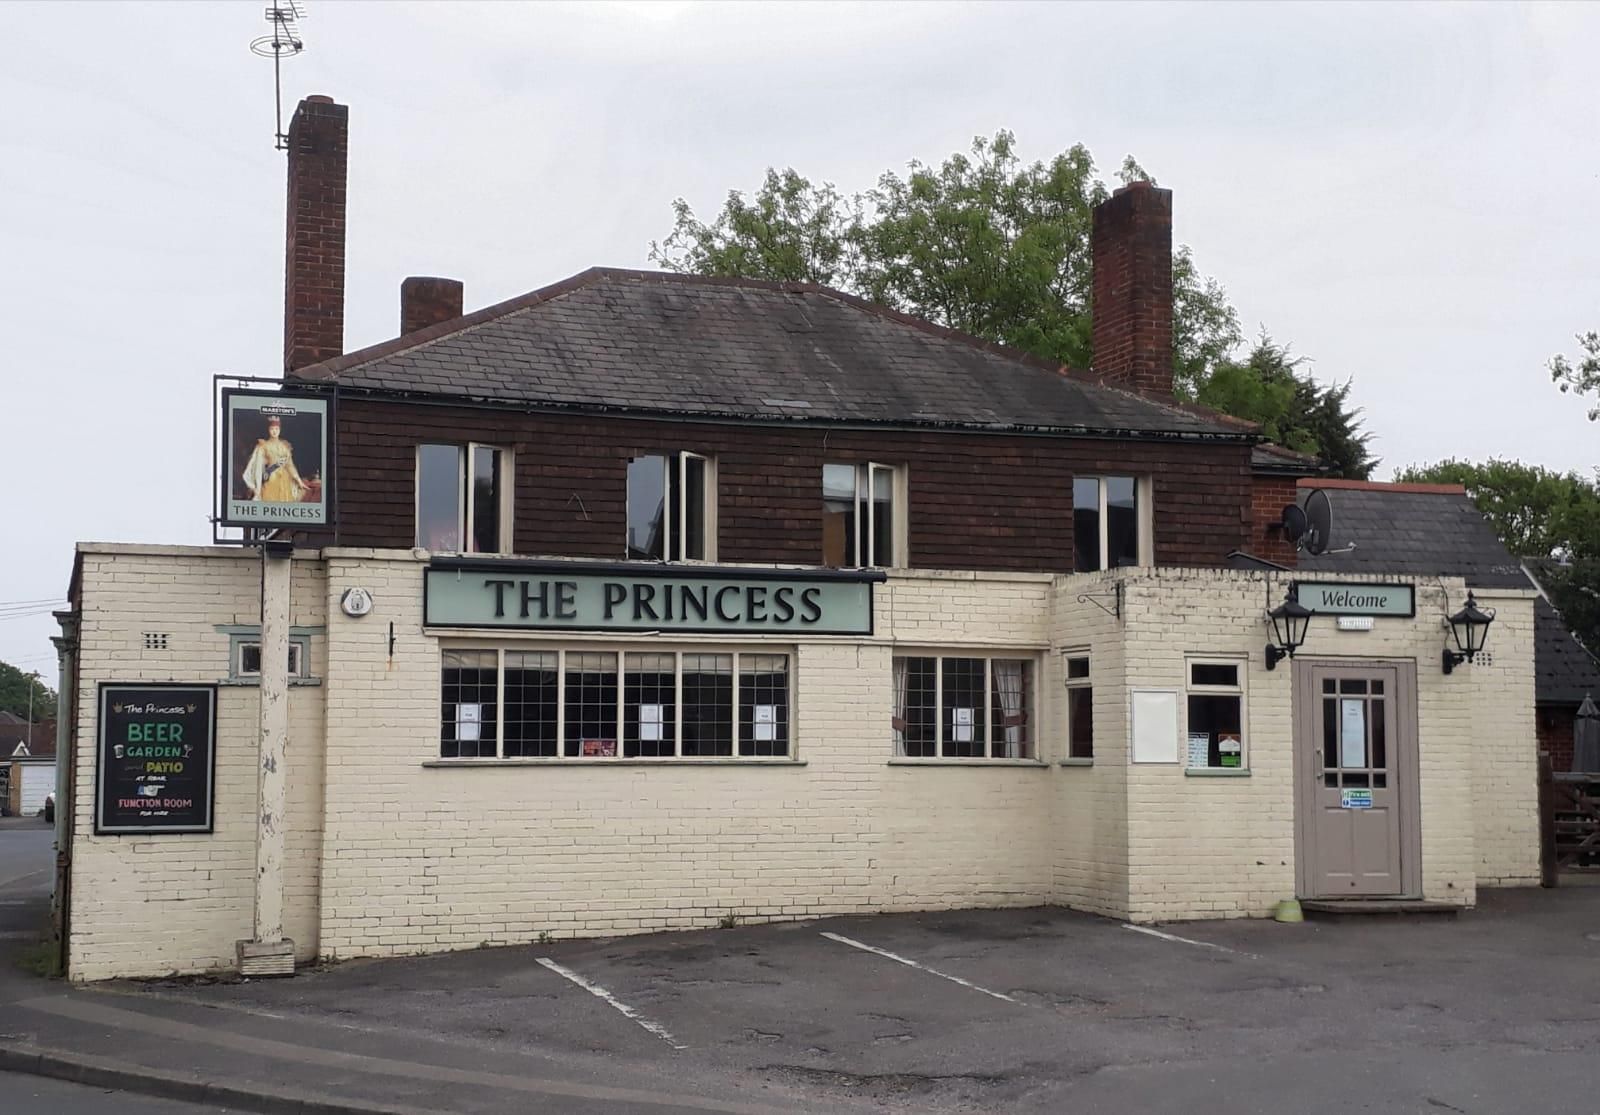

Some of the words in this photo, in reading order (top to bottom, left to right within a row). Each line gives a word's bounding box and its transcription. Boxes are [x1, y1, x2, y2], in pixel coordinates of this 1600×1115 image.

[233, 505, 258, 516] THE
[263, 506, 321, 518] PRINCESS
[484, 580, 578, 618] THE
[603, 583, 822, 623] PRINCESS
[1322, 590, 1388, 608] Welcome
[124, 704, 143, 714] The
[145, 703, 186, 714] Princess
[128, 723, 184, 742] BEER
[127, 747, 182, 758] GARDEN
[146, 762, 184, 773] PATIO
[119, 799, 161, 808] FUNCTION
[164, 799, 192, 808] ROOM
